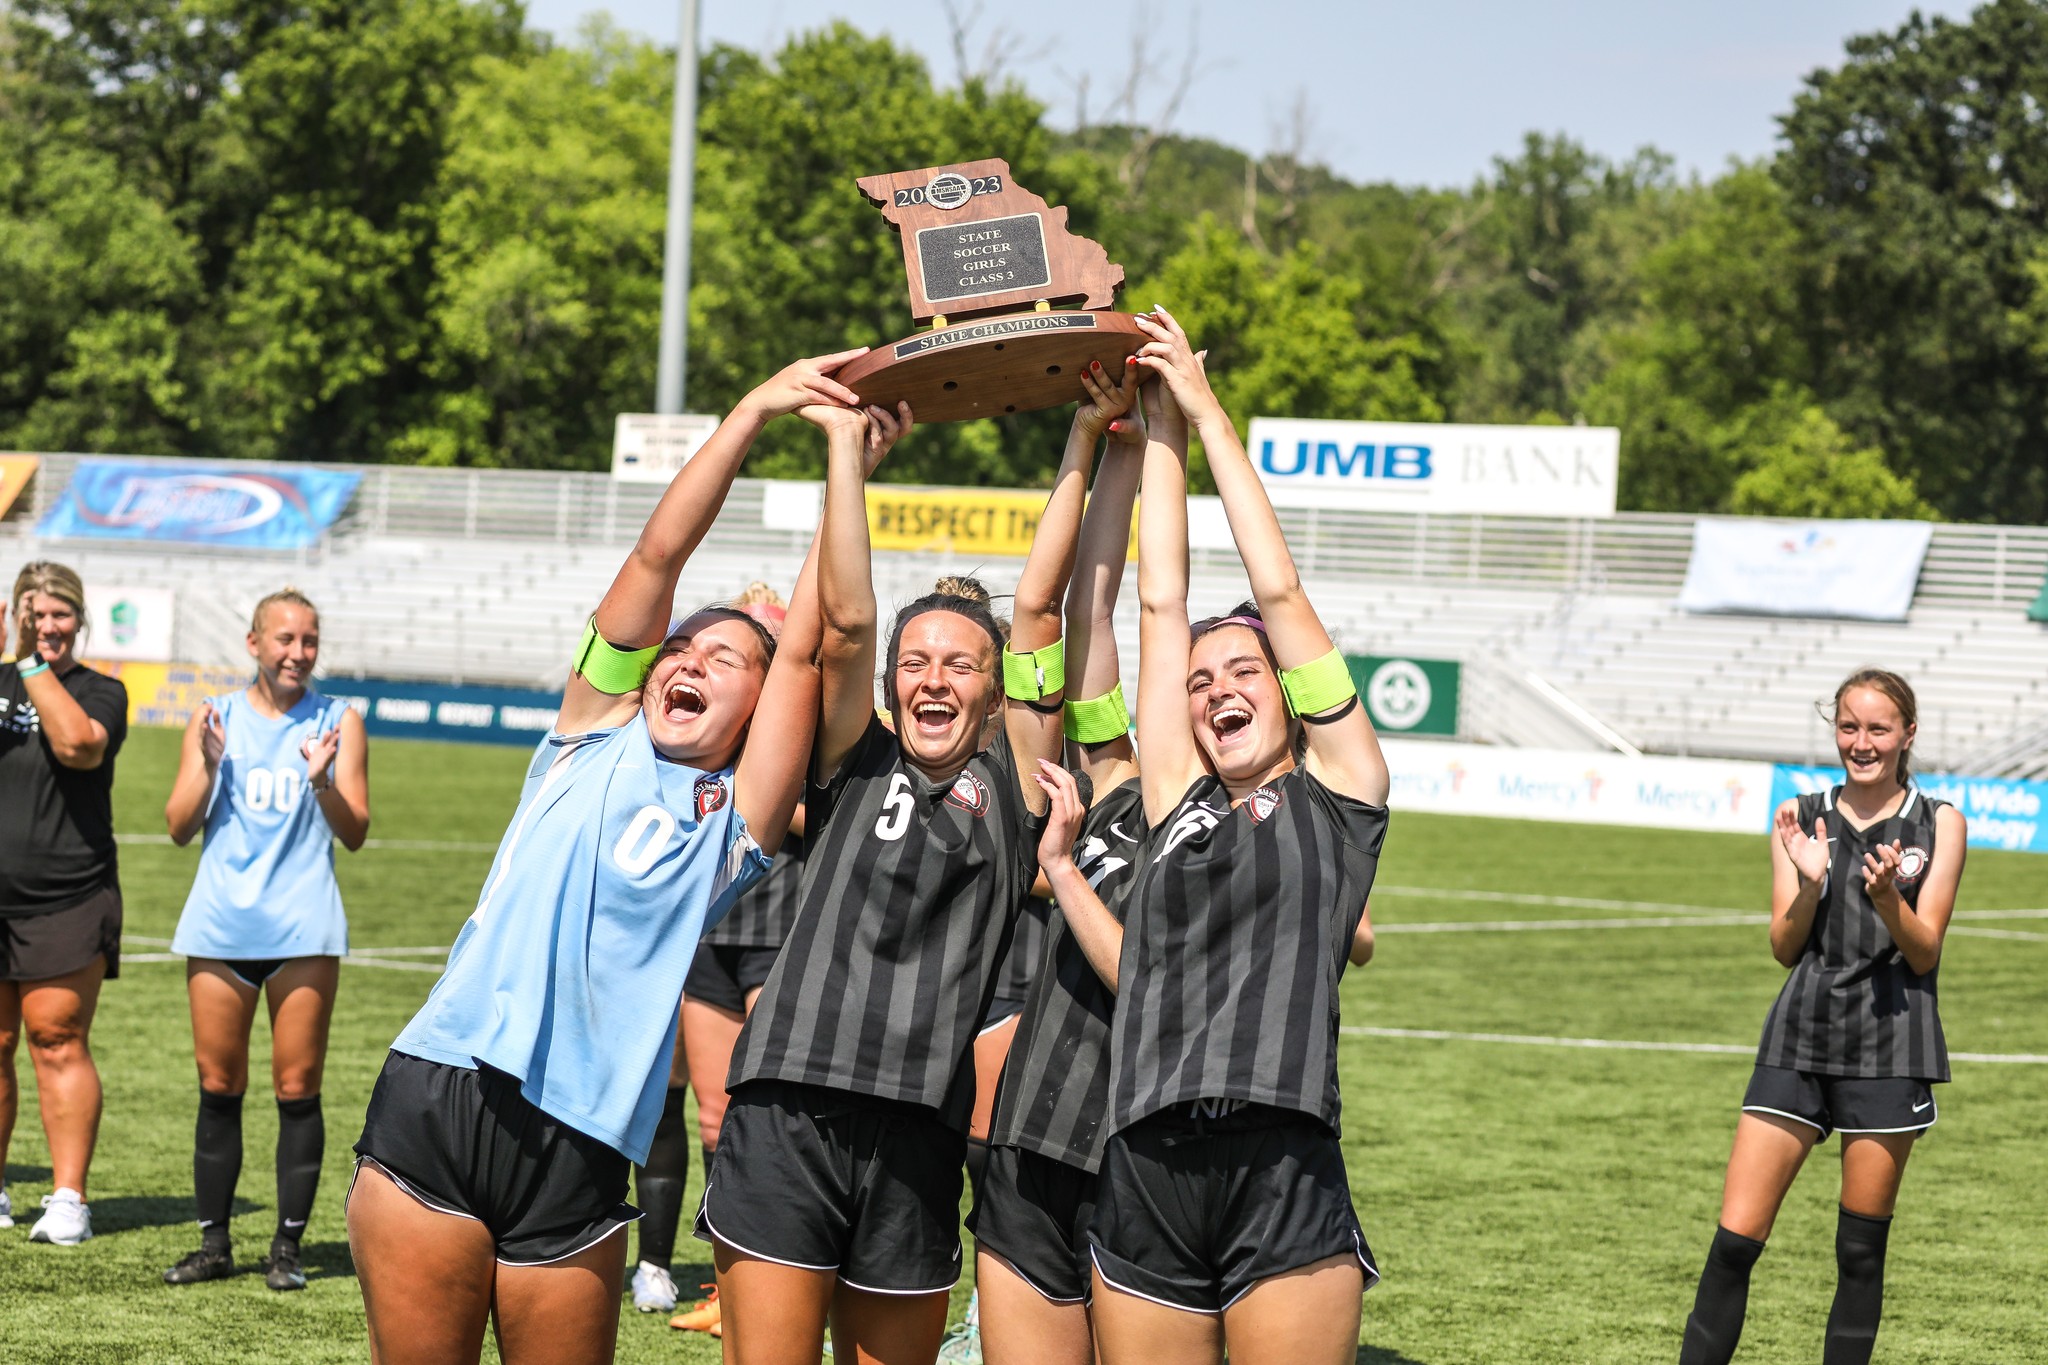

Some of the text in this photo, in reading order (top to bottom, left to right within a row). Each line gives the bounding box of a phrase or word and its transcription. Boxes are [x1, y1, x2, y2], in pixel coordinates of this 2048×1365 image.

[896, 176, 1001, 207] 20 23
[953, 242, 1013, 259] SOCCER
[958, 229, 1003, 244] STATE
[959, 271, 1015, 287] CLASS 3
[963, 257, 1007, 272] GIRLS
[920, 316, 1070, 350] STATE CHAMPIONS
[1260, 439, 1605, 487] UMB BANK
[877, 503, 1043, 541] RESPECT TH
[245, 766, 301, 814] 00
[1389, 772, 1444, 799] ercy
[1635, 781, 1720, 818] Mercy
[1967, 783, 2041, 818] Wide
[874, 772, 916, 841] 5
[612, 803, 676, 874] 0
[1966, 815, 2038, 850] ology
